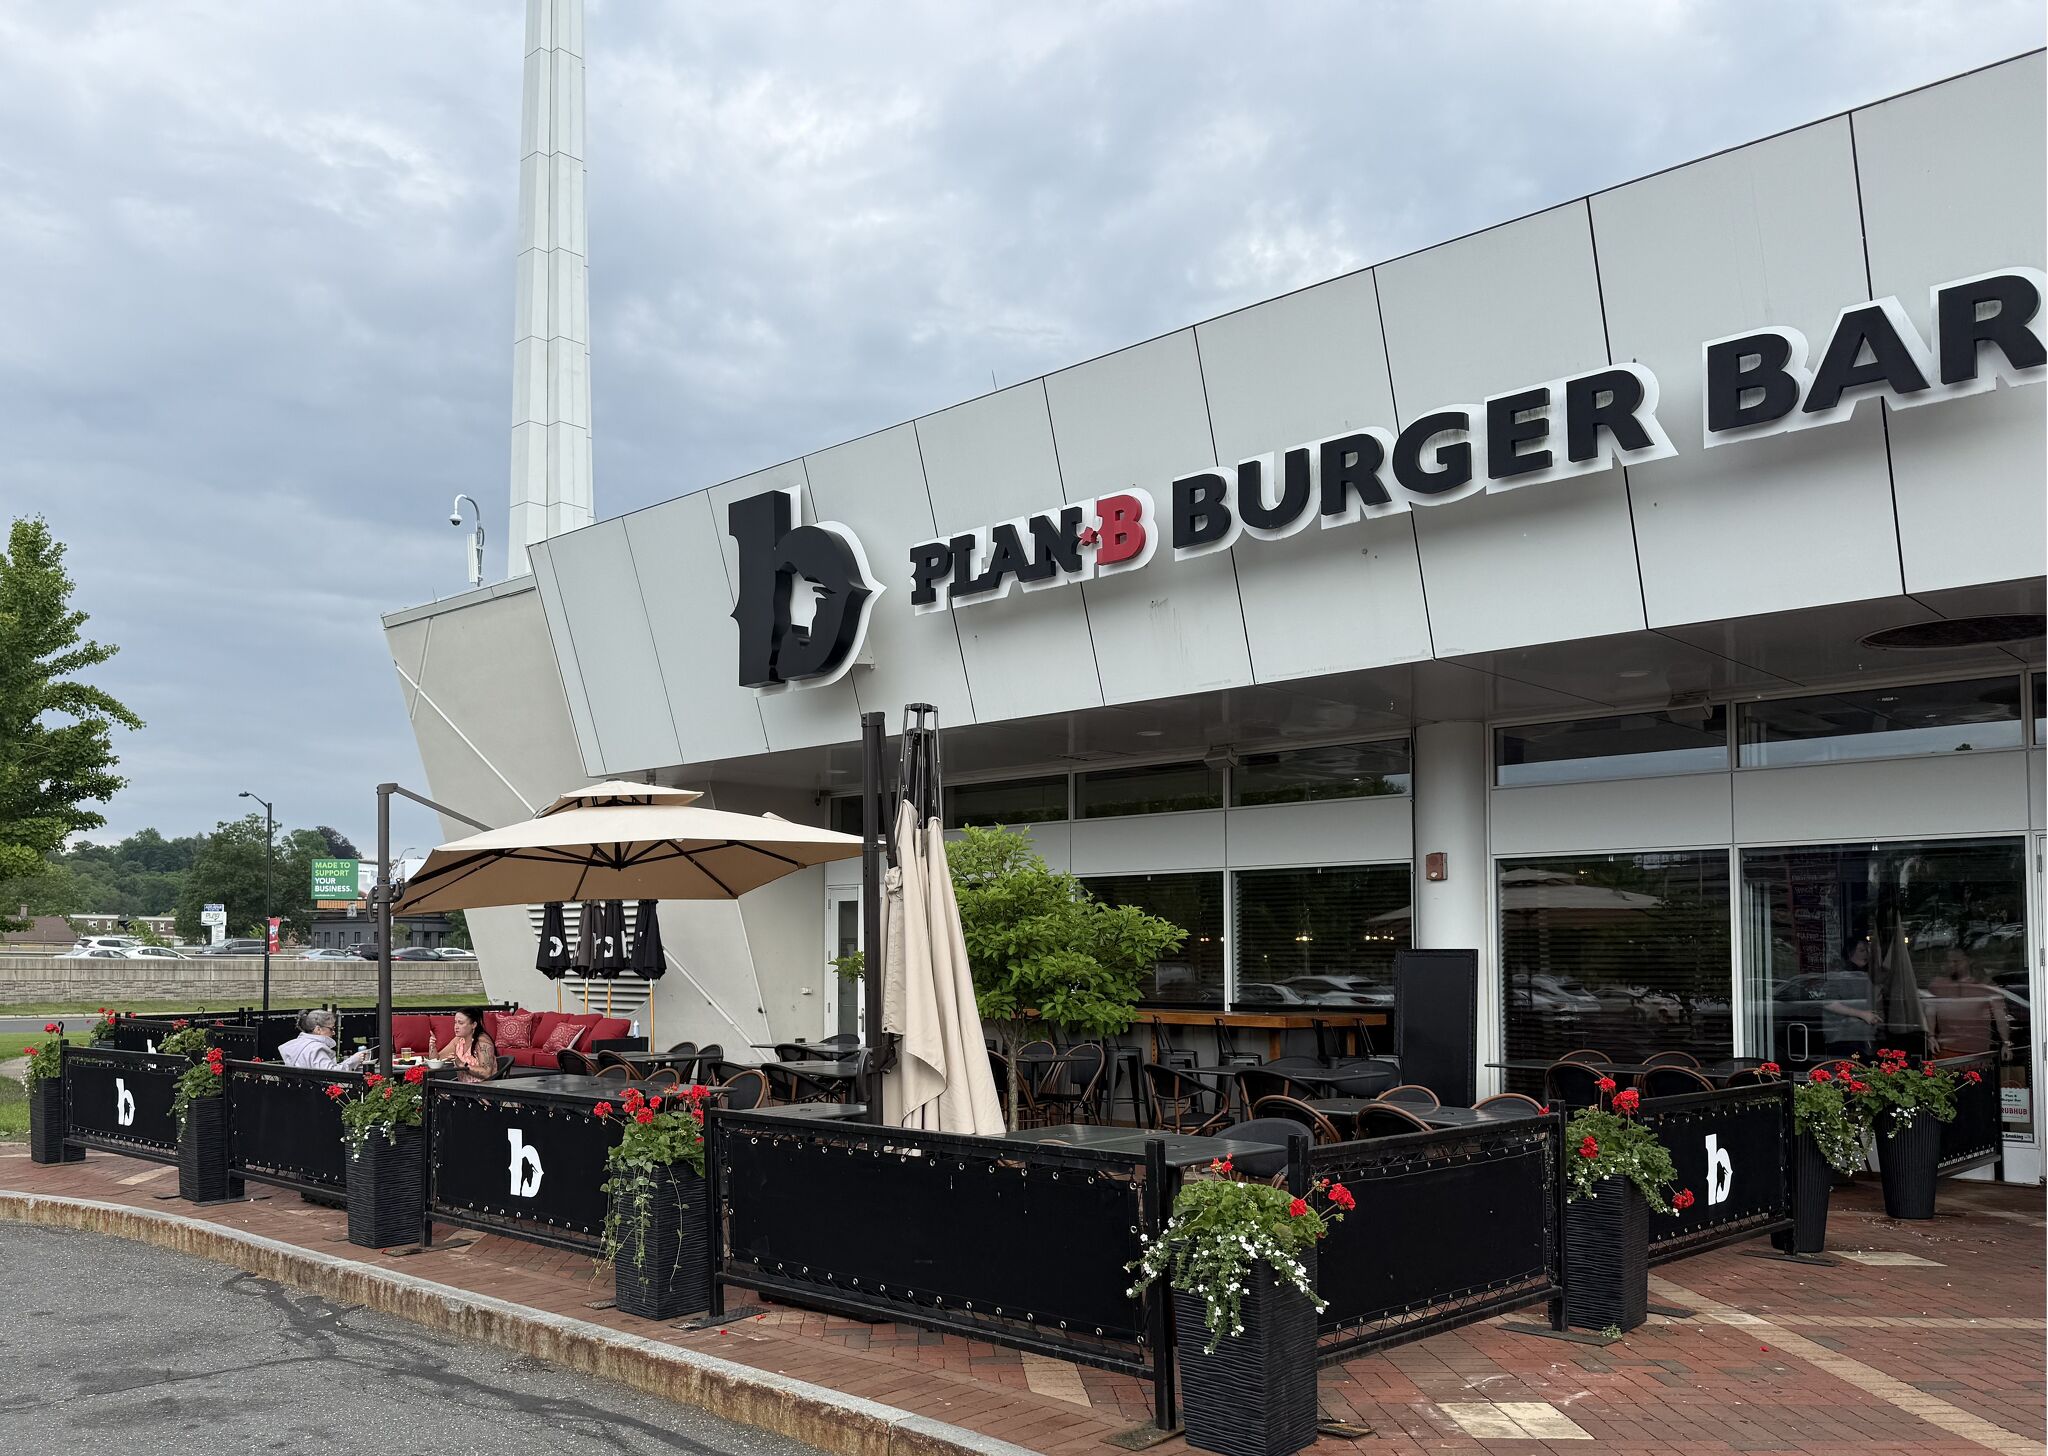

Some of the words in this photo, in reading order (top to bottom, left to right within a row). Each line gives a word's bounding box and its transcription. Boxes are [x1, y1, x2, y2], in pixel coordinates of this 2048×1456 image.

[910, 507, 1083, 606] PLAN
[1172, 368, 1656, 550] BURGER
[1707, 274, 2048, 433] BAR
[2000, 1107, 2028, 1115] RUBHUB
